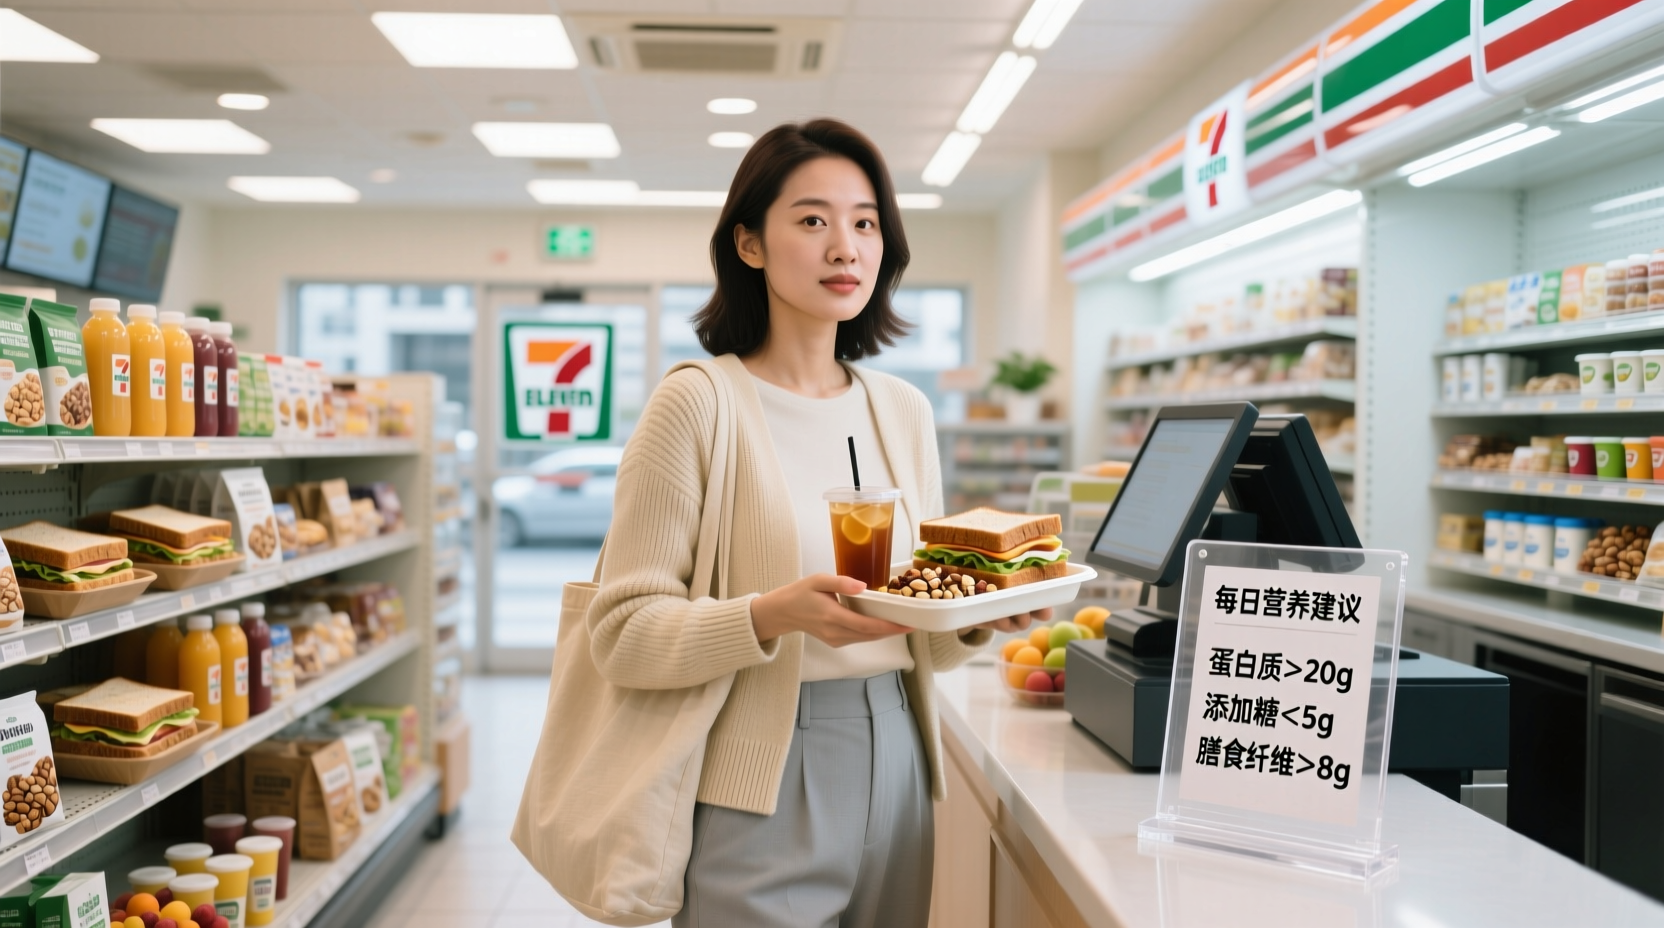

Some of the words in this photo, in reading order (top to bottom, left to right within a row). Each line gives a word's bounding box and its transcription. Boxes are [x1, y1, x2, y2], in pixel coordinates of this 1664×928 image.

[527, 341, 592, 432] 7
[1214, 585, 1362, 624] 每日营养建议
[1208, 647, 1354, 694] 蛋白质>20g
[1202, 692, 1334, 739] 添加糖<5g
[1195, 736, 1351, 790] 膳食纤维>8g
